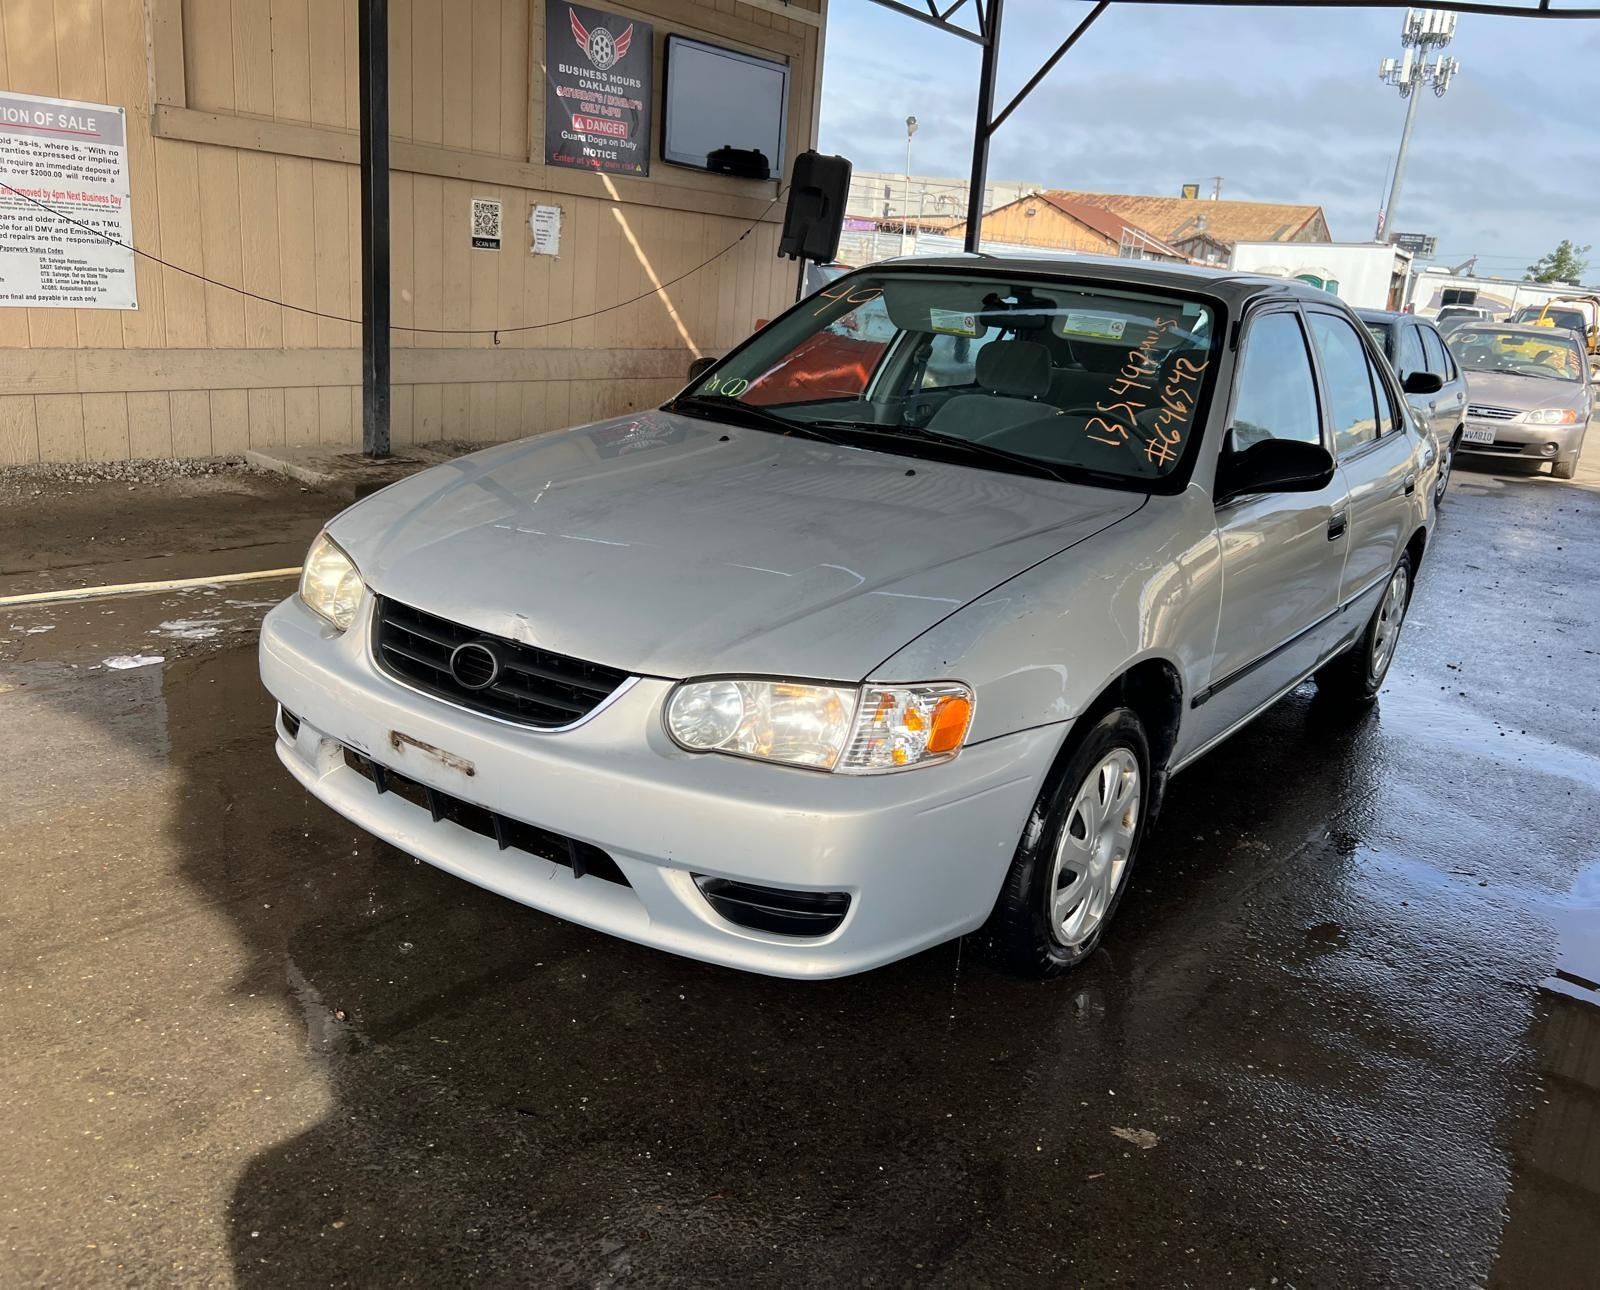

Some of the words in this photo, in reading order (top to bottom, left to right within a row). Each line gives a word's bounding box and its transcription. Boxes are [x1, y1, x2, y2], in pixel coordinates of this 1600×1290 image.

[558, 63, 607, 82] BUSINESS
[610, 74, 641, 88] HOURS
[579, 79, 623, 95] OAKLAND
[0, 106, 29, 123] ION
[34, 111, 54, 126] OF
[58, 114, 97, 131] SALE
[587, 119, 625, 135] DANGER
[44, 142, 69, 151] where
[561, 130, 586, 142] Guard
[588, 132, 607, 146] Dogs
[609, 137, 619, 146] on
[620, 139, 637, 151] Duty
[33, 150, 76, 161] expressed
[88, 155, 120, 165] implied.
[583, 147, 617, 160] NOTICE
[6, 159, 34, 167] require
[46, 162, 84, 171] immediate
[85, 166, 111, 175] deposit
[30, 169, 62, 178] $2000.00
[82, 175, 106, 183] require
[14, 187, 42, 198] removed
[43, 189, 50, 200] by
[52, 190, 66, 201] 4pm
[67, 190, 81, 200] Next
[82, 192, 110, 203] Business
[110, 194, 122, 206] Day
[70, 228, 102, 236] Emission
[66, 236, 113, 246] responsibility
